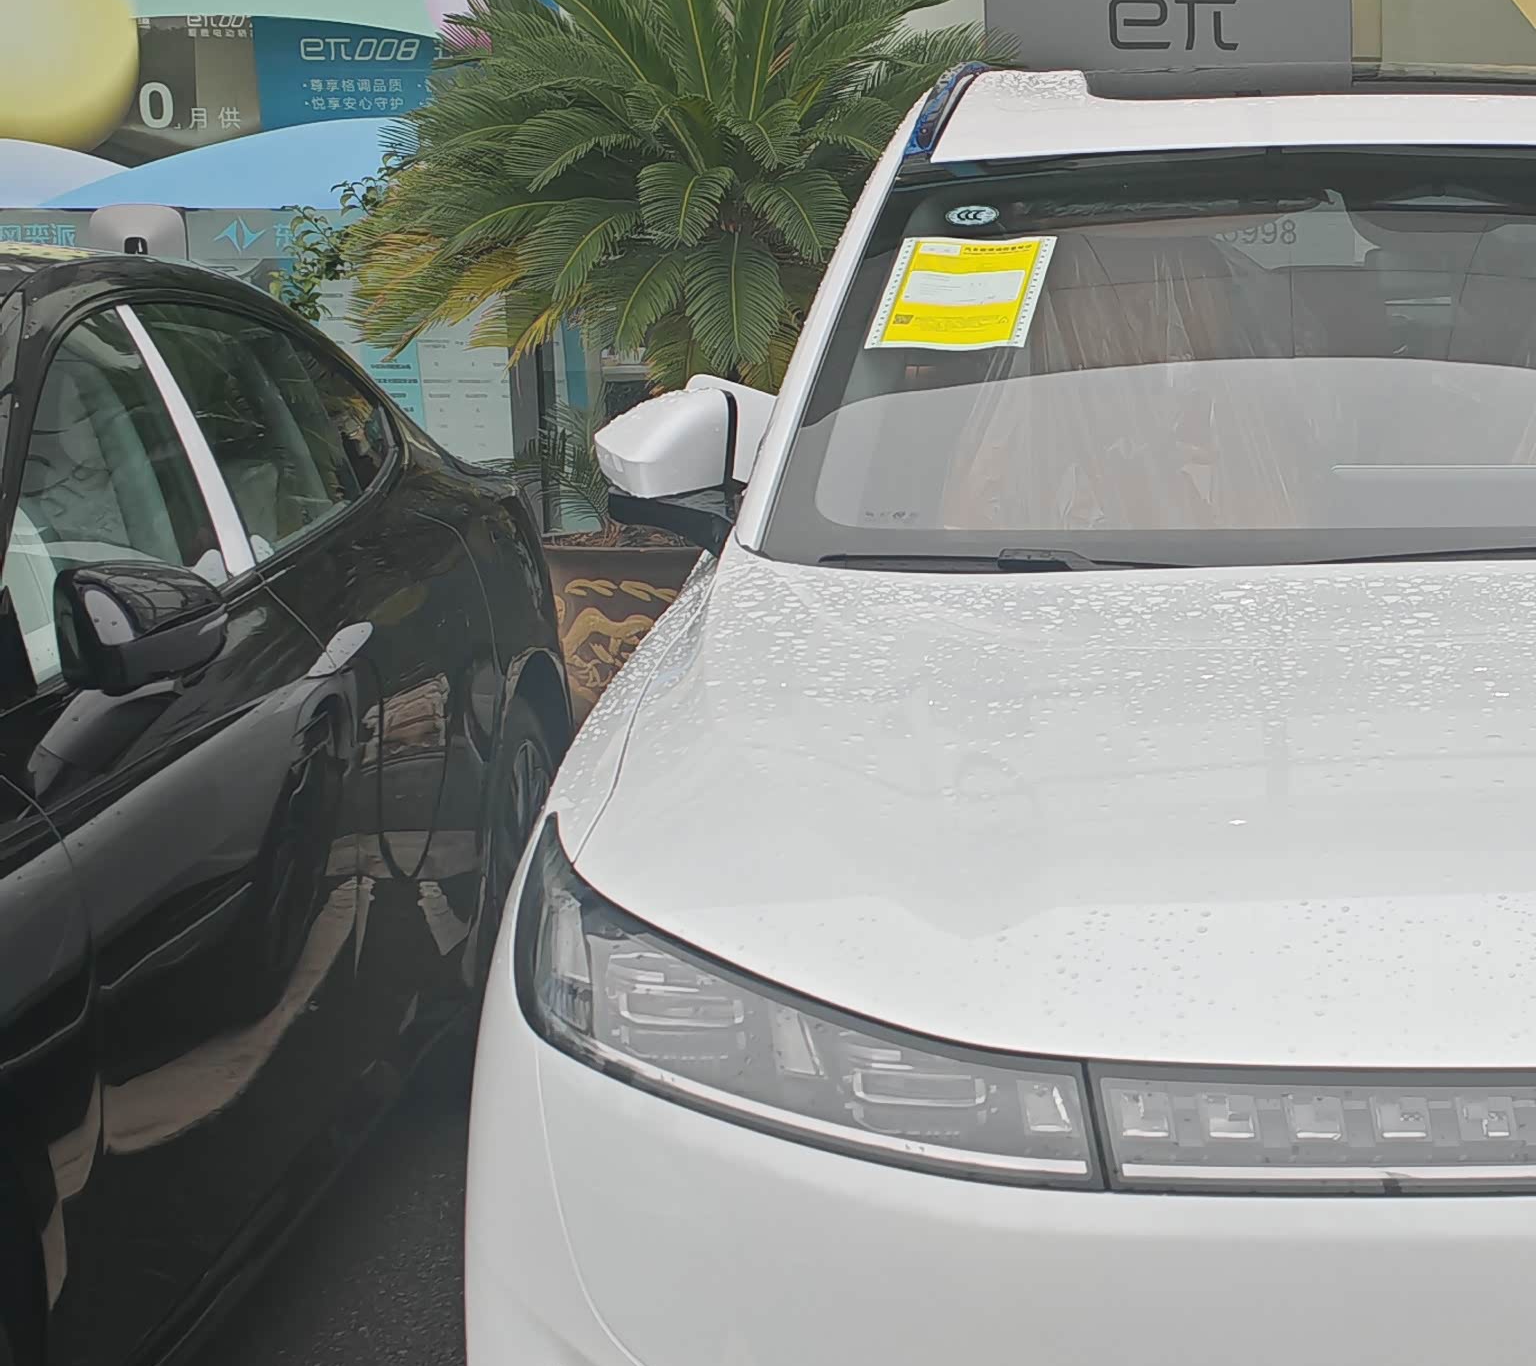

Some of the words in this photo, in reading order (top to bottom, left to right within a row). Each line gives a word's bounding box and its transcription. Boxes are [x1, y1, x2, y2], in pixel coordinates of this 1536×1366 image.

[310, 78, 403, 92] 尊享格调品质
[311, 97, 404, 110] 悦享安心守护
[189, 106, 241, 129] 月供
